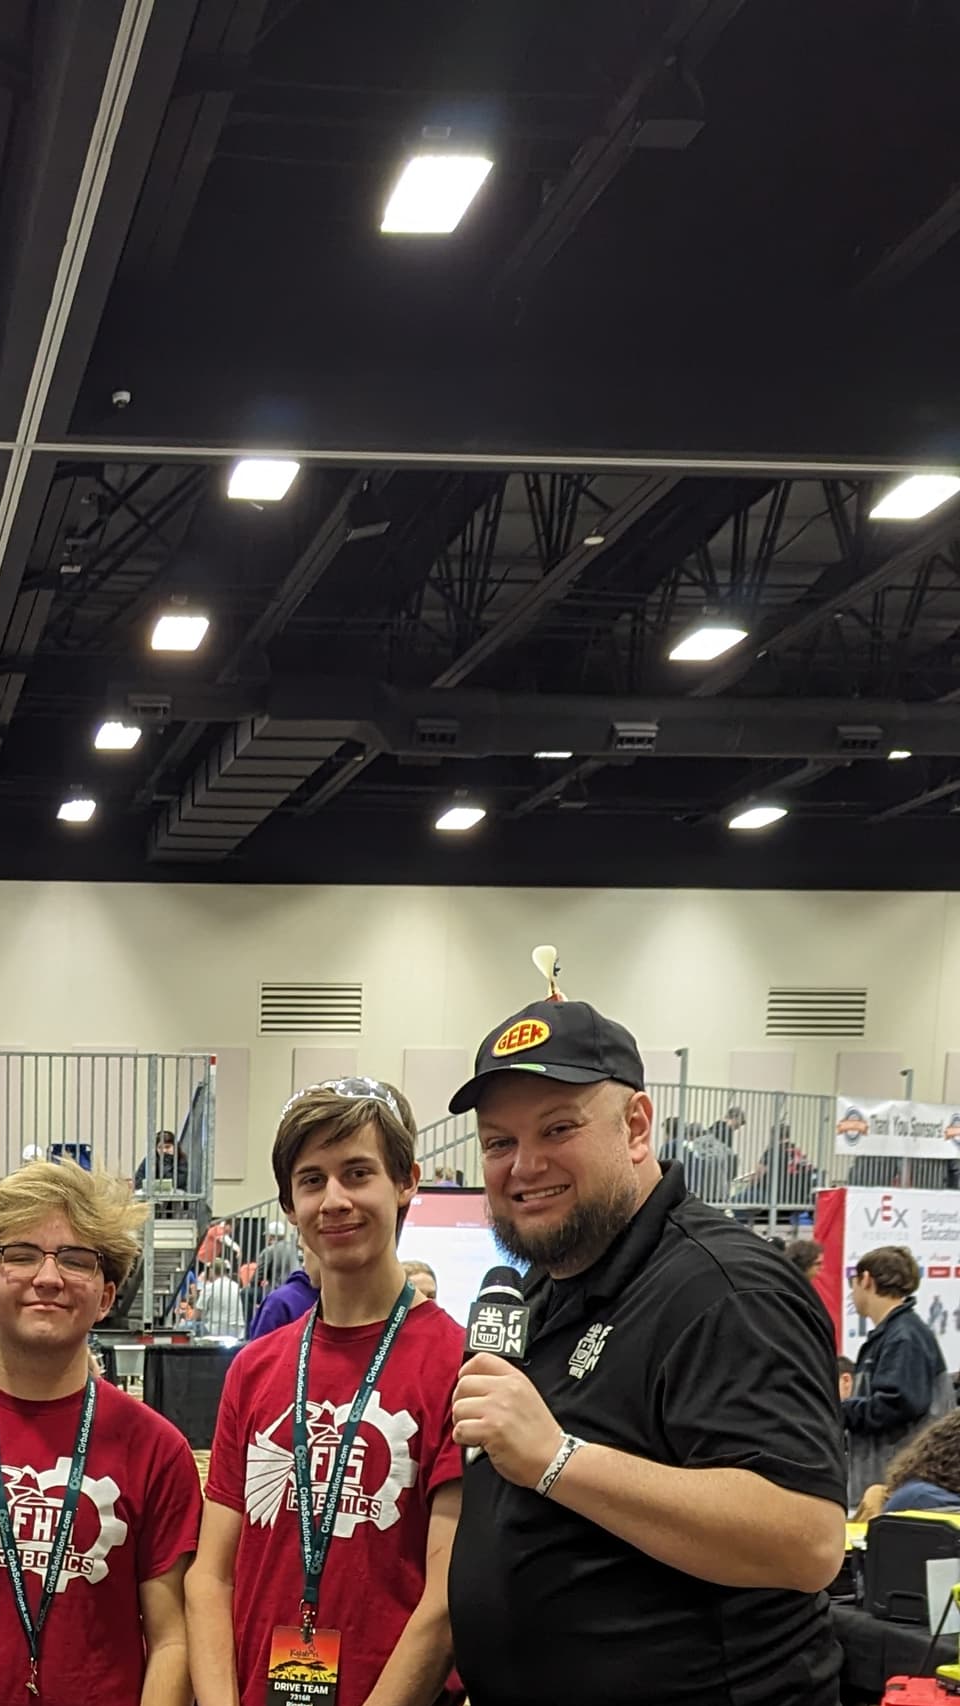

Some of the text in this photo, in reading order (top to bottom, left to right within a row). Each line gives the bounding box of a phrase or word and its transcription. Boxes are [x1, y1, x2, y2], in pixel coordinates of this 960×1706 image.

[498, 1024, 544, 1049] GEEK
[864, 1195, 908, 1228] VEX
[366, 1306, 406, 1383] CirbaSolutions.com
[505, 1310, 525, 1353] FUN
[585, 1325, 614, 1371] FUN
[321, 1445, 349, 1533] CirbaSolutions.com
[47, 1511, 72, 1593] CirbaSolutions.com
[7, 1549, 32, 1632] CirbaSolutions.com
[274, 1682, 328, 1694] DRIVE TEAM
[290, 1693, 311, 1702] 7316R
